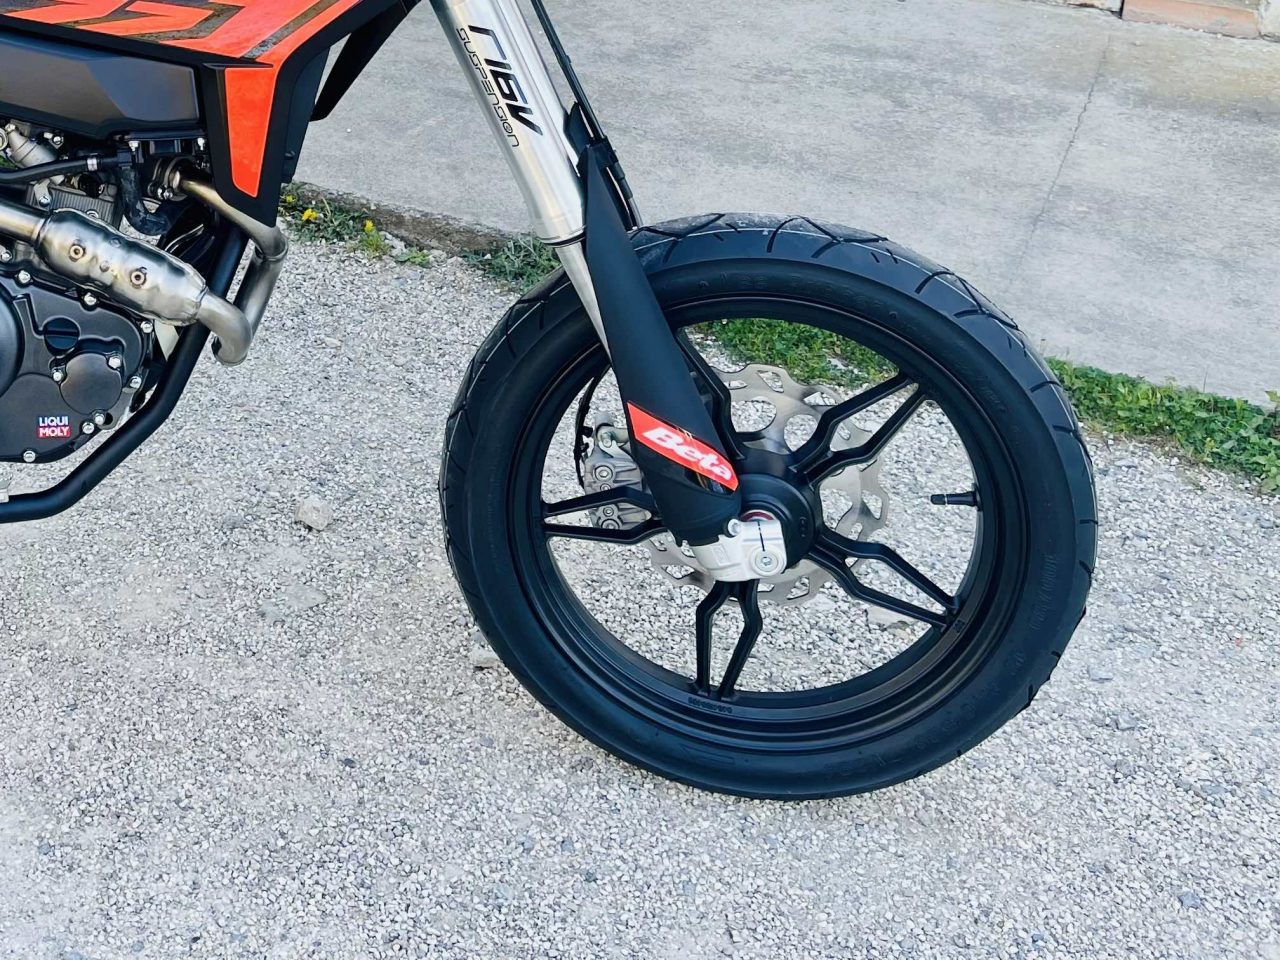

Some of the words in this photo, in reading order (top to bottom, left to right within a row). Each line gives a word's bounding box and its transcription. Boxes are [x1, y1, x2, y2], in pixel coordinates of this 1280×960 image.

[39, 416, 69, 427] LIQUI
[39, 427, 70, 438] MOLY
[641, 427, 733, 481] Beta
